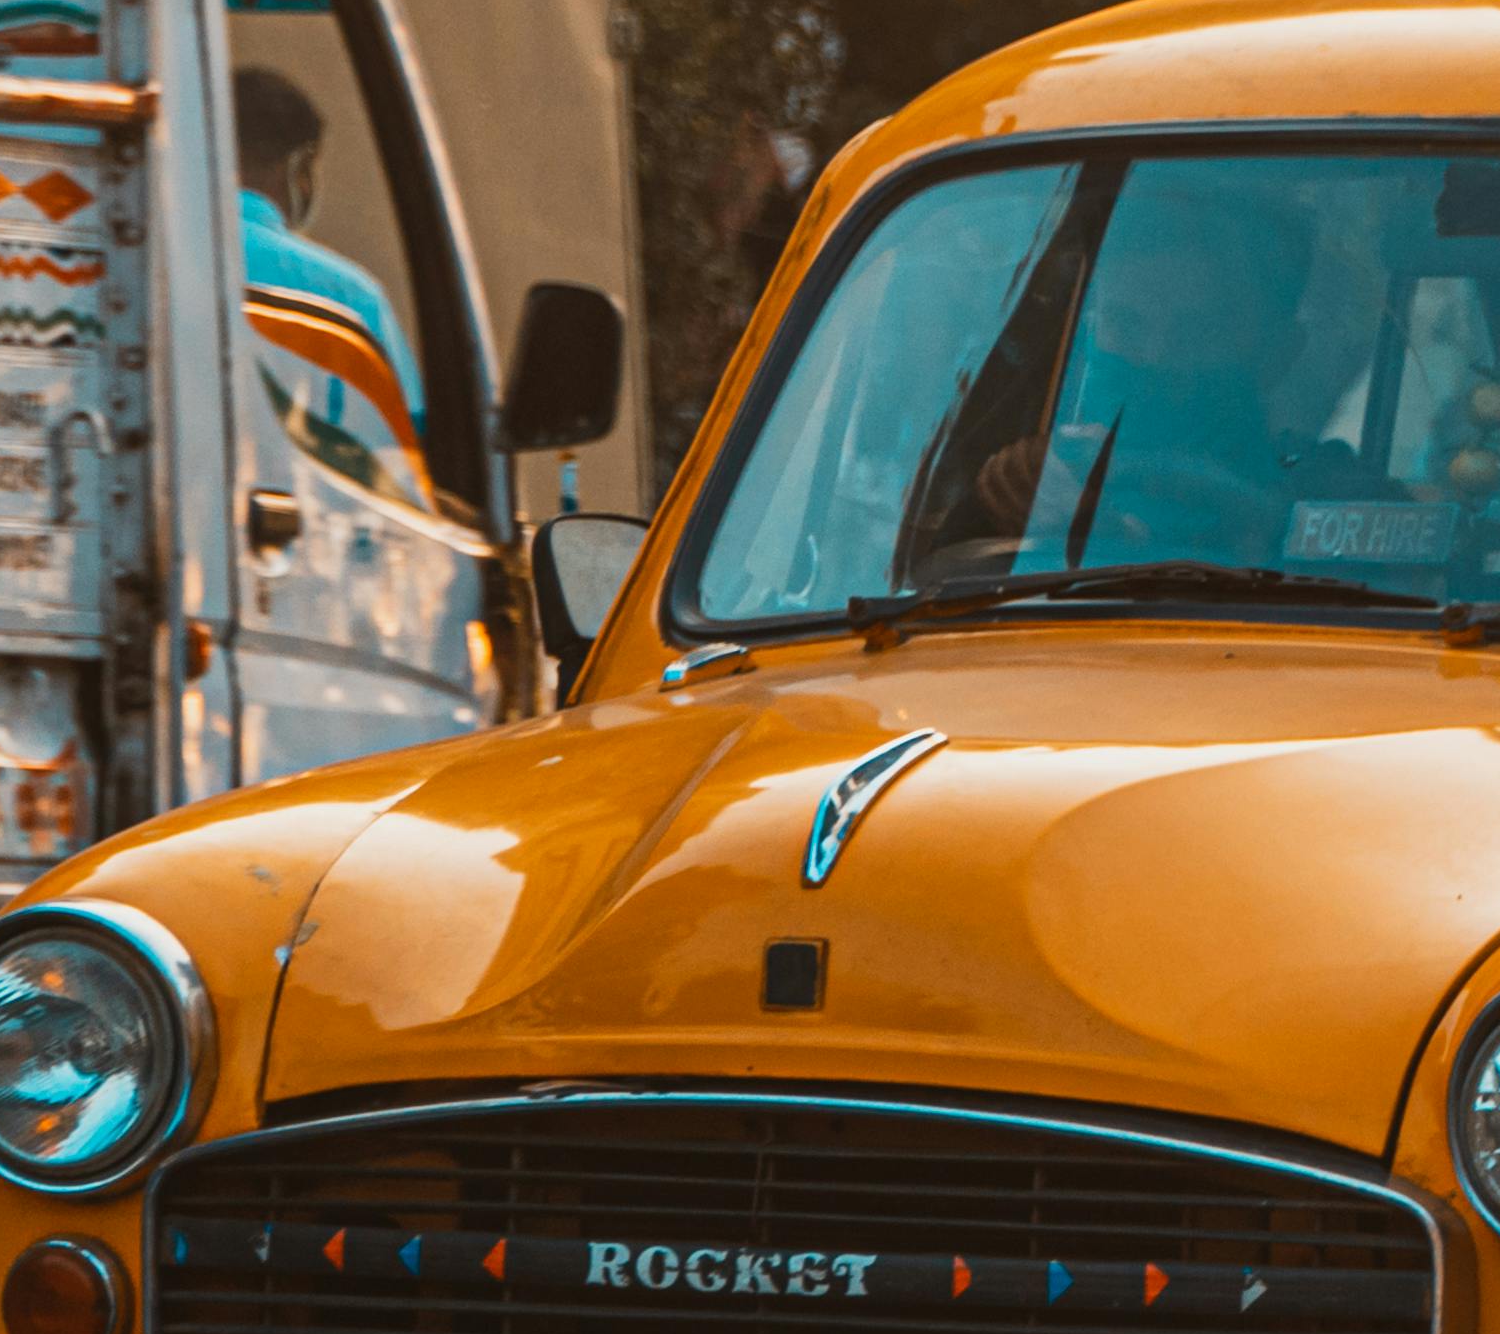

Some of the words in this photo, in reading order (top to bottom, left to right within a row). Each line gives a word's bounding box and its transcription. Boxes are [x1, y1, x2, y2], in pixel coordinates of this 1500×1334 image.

[1299, 511, 1364, 555] FOR
[1366, 512, 1438, 555] HIRE
[585, 1241, 878, 1297] ROCKET
